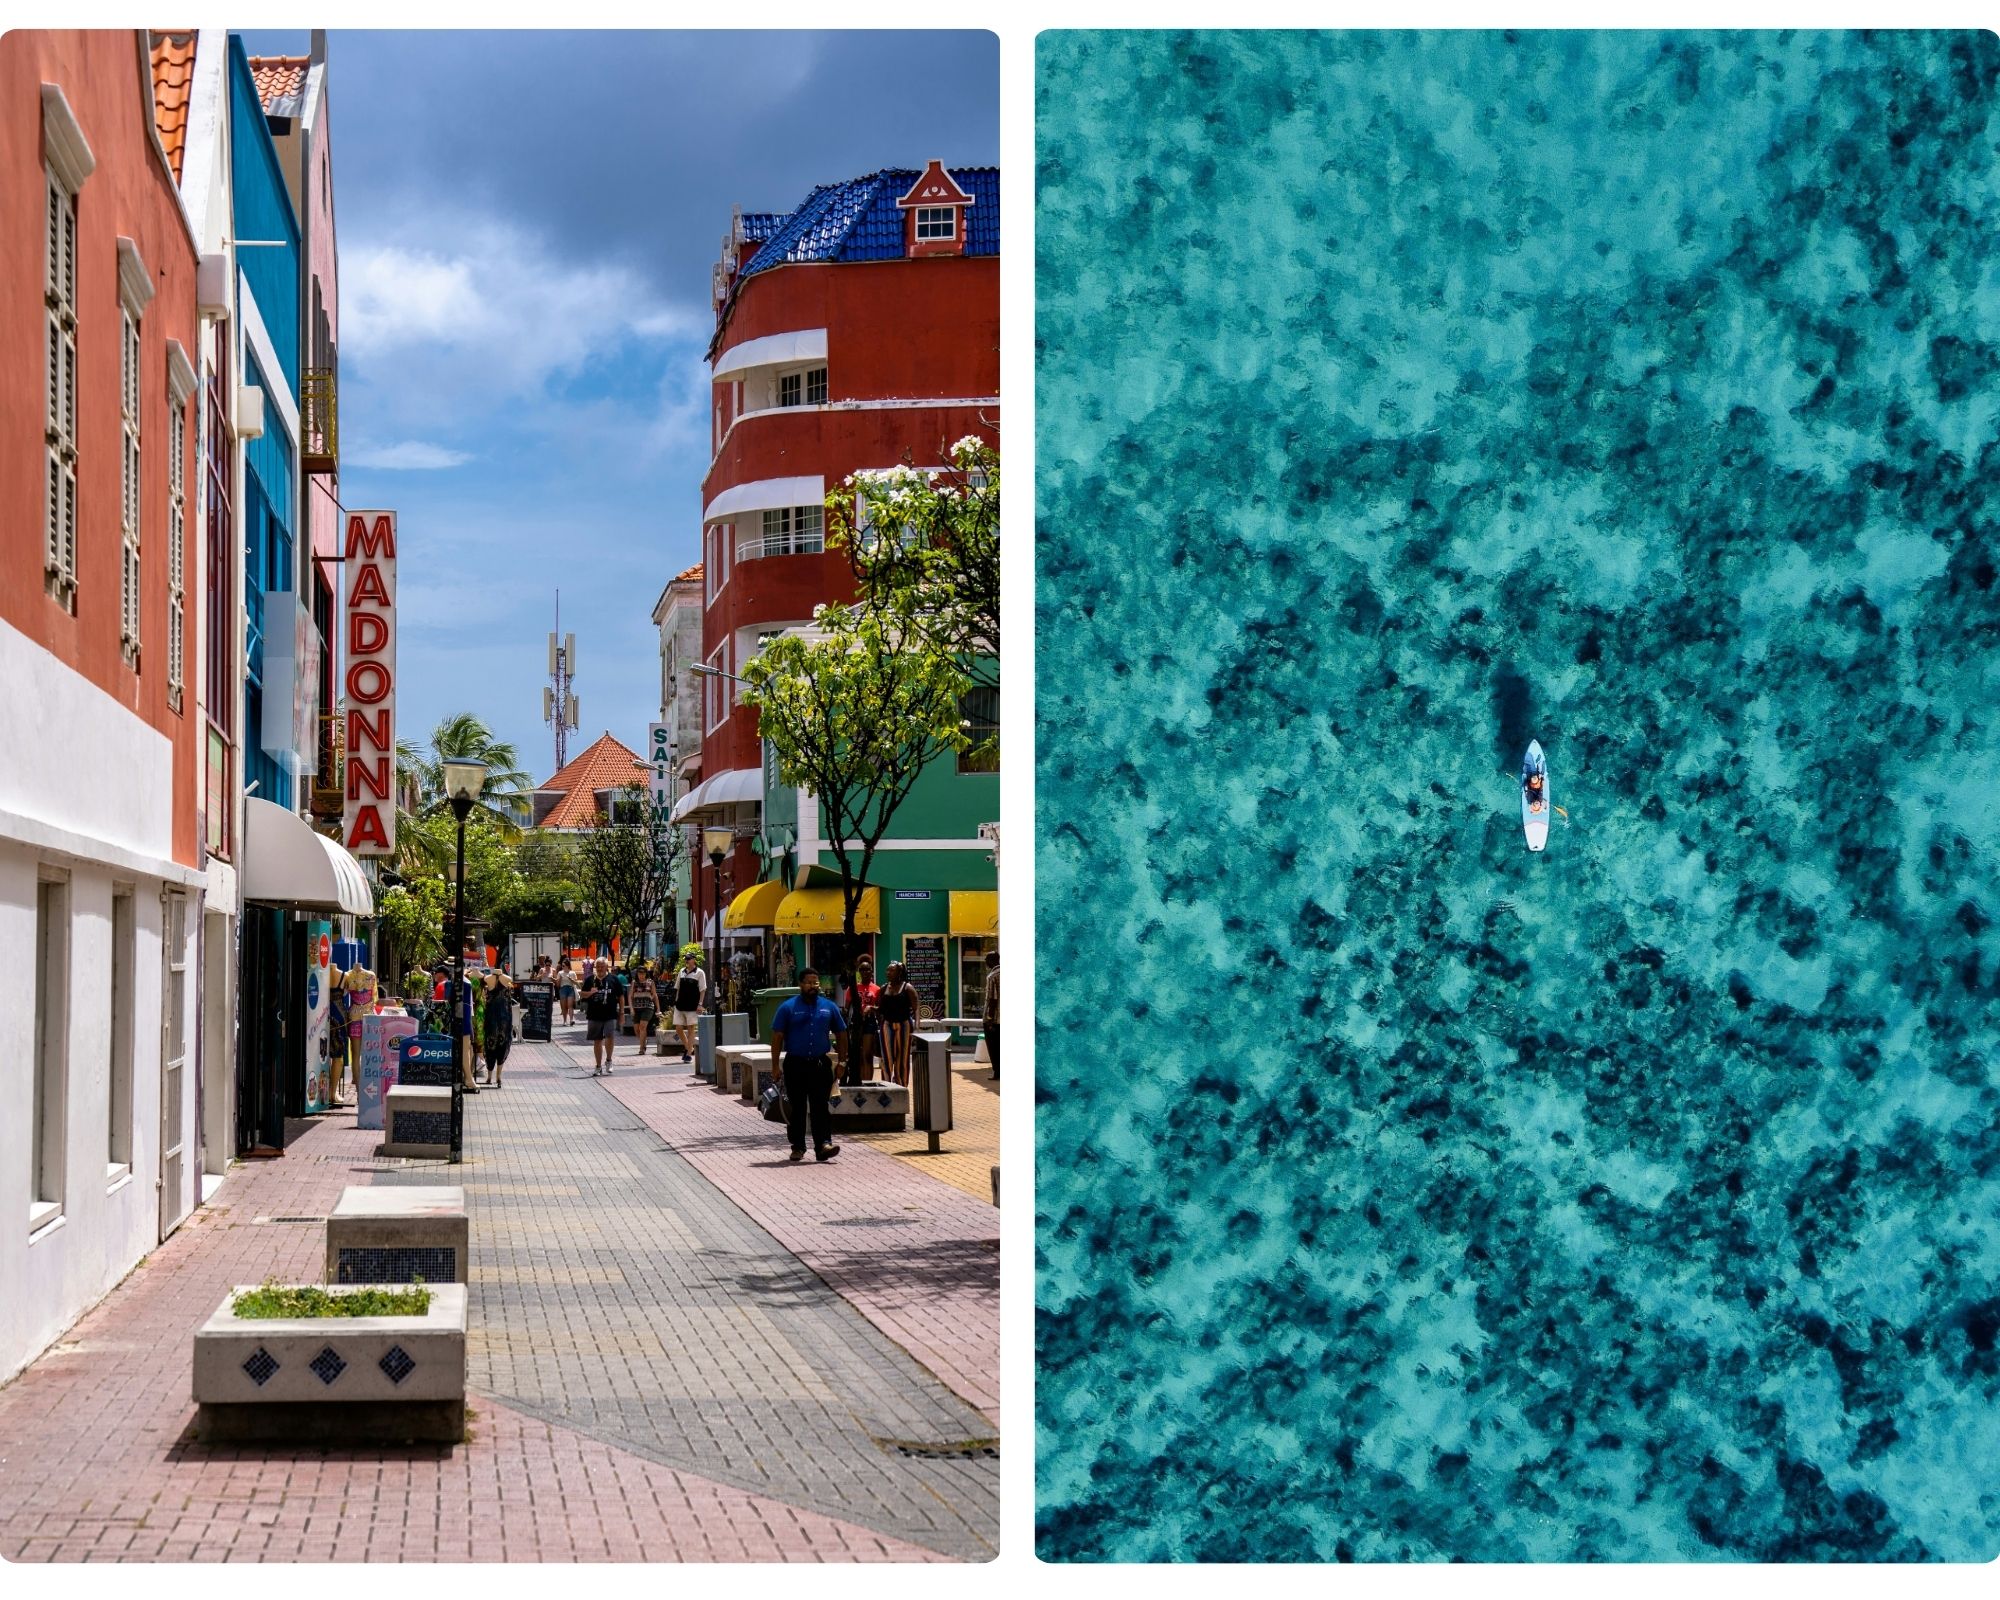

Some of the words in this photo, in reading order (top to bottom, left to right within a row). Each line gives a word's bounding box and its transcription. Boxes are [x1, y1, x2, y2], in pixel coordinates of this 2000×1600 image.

[345, 515, 395, 849] MADONNA
[365, 1054, 386, 1066] you
[423, 1050, 452, 1059] pepsi
